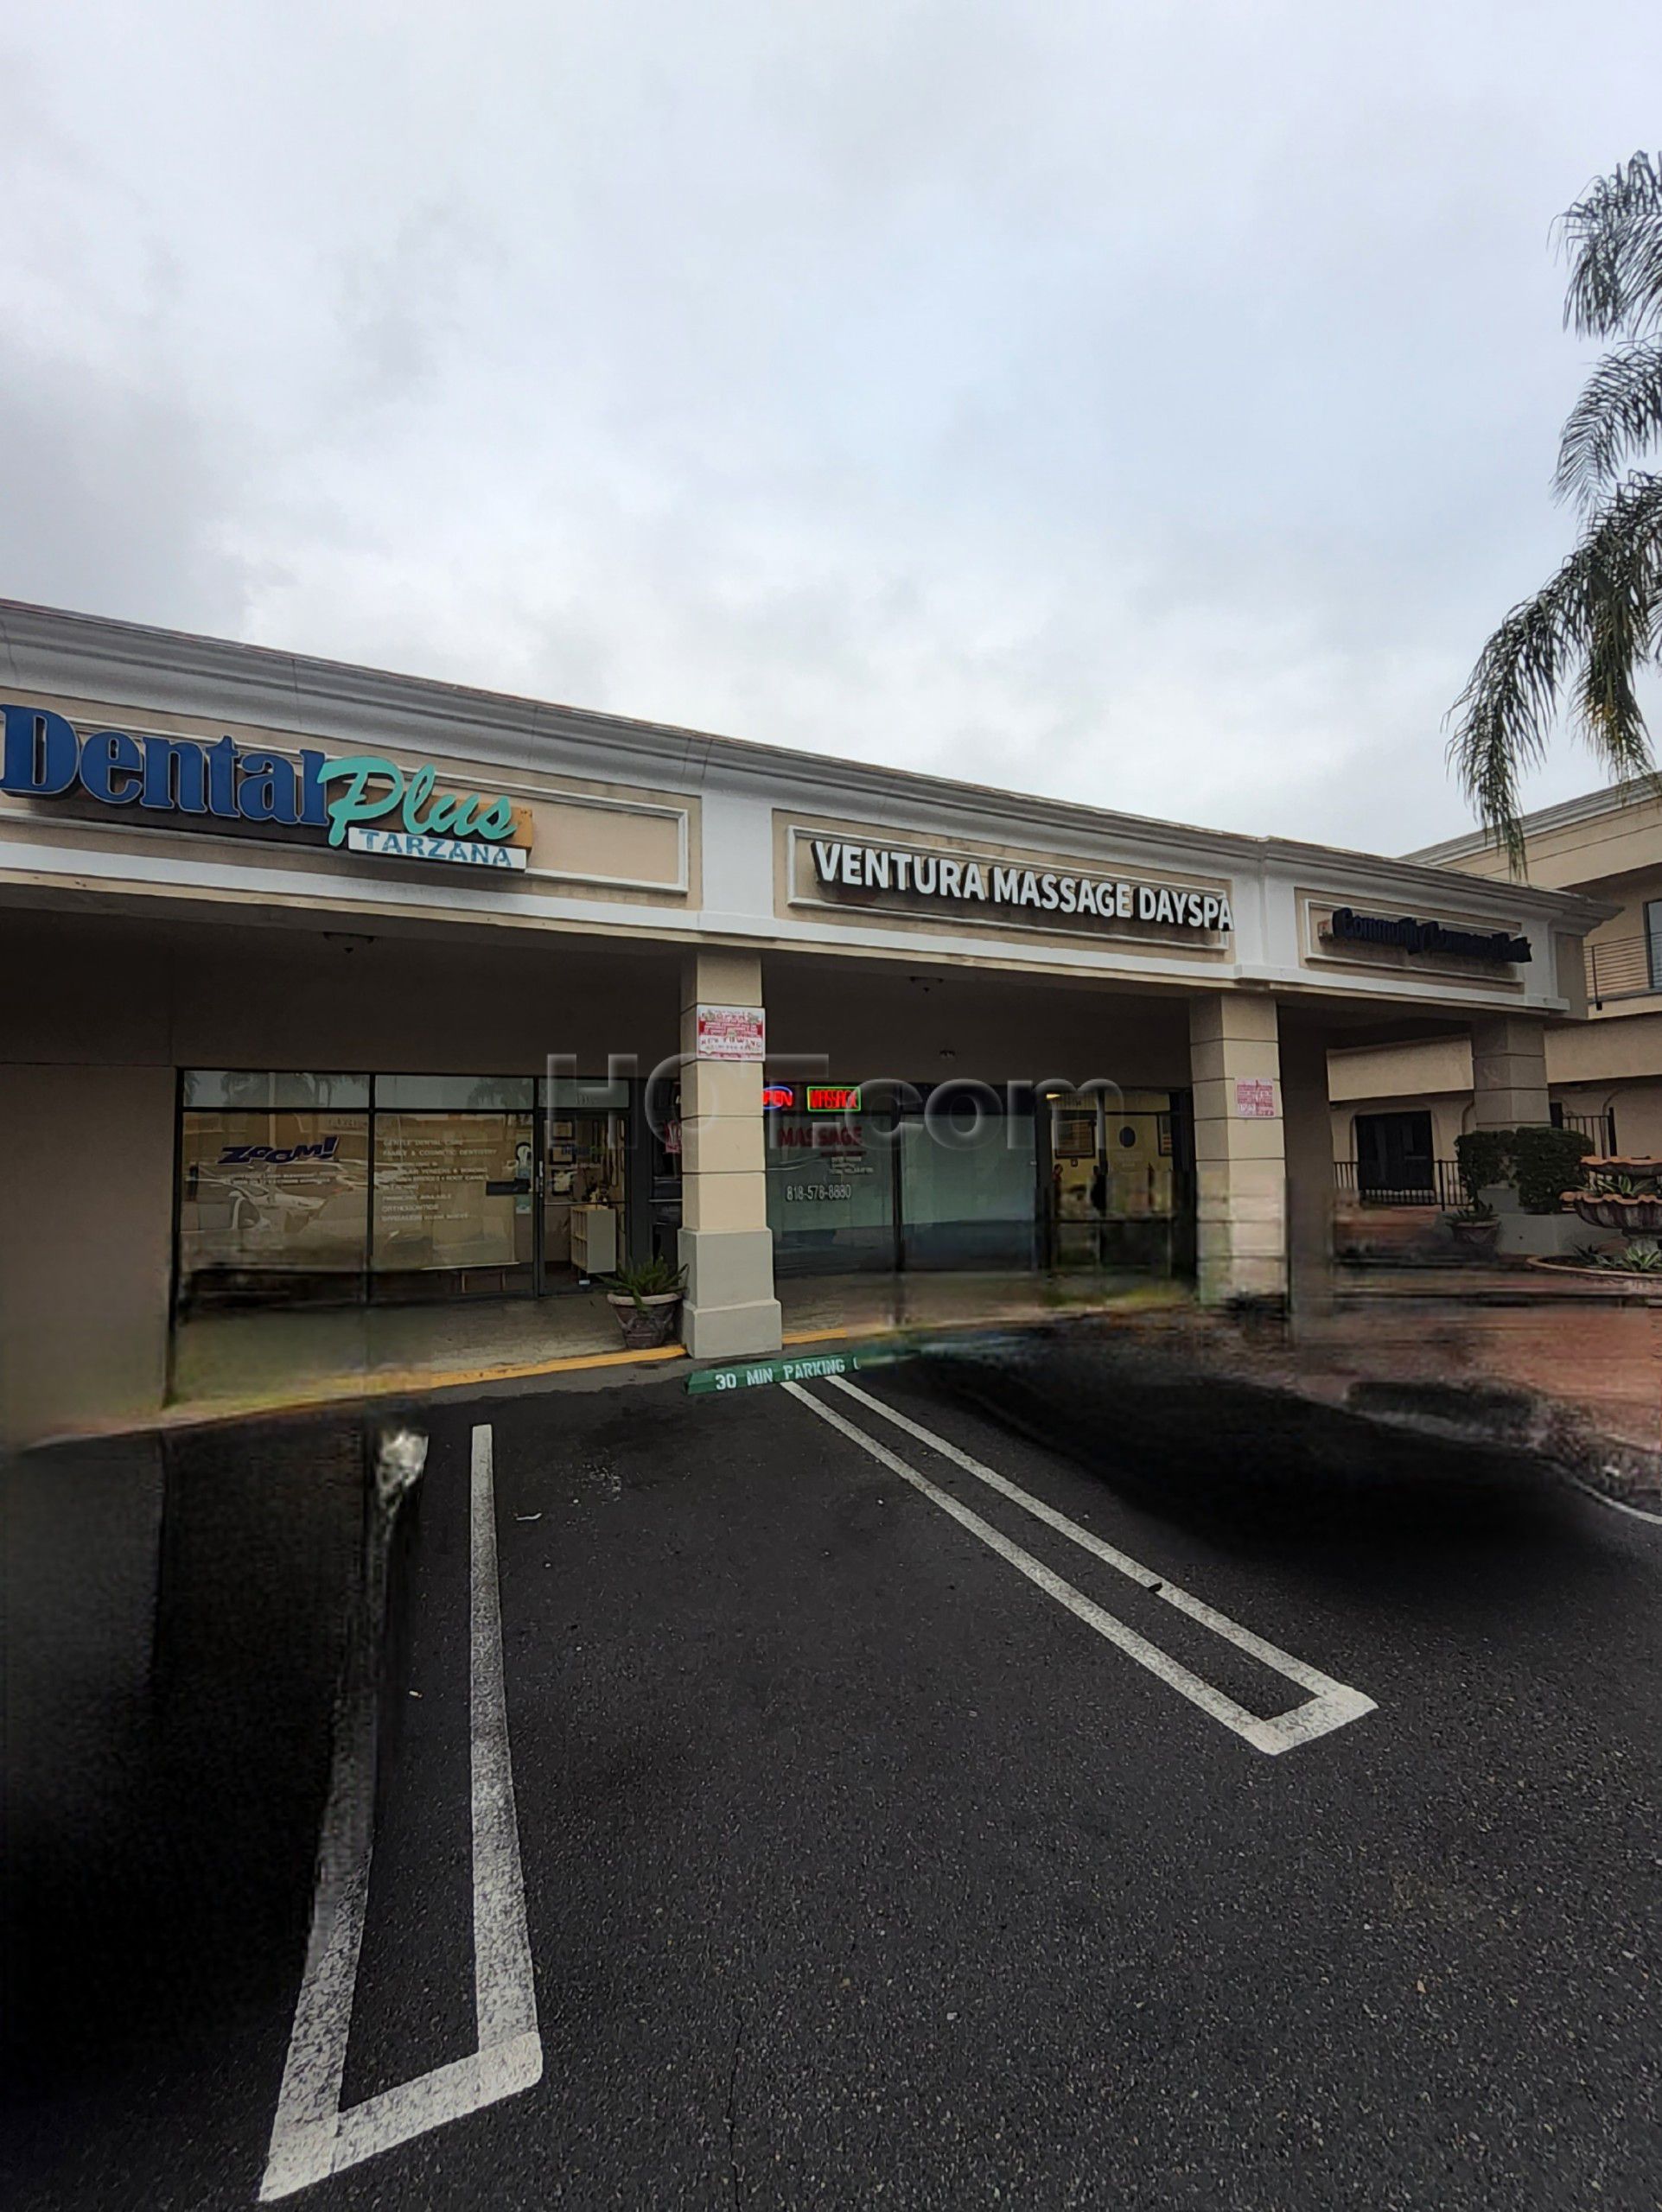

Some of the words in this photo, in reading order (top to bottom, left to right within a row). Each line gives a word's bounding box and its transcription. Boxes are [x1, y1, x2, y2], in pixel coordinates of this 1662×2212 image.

[0, 703, 329, 827] Dental
[316, 754, 519, 848] Plus
[359, 829, 513, 869] TARZANA
[812, 841, 986, 902] VENTURA
[992, 865, 1133, 918] MASSAGE
[763, 1090, 793, 1107] PEN
[778, 1126, 863, 1147] MASSAGE
[715, 1373, 737, 1390] 30
[747, 1368, 774, 1387] MIN
[782, 1358, 846, 1381] PARKING
